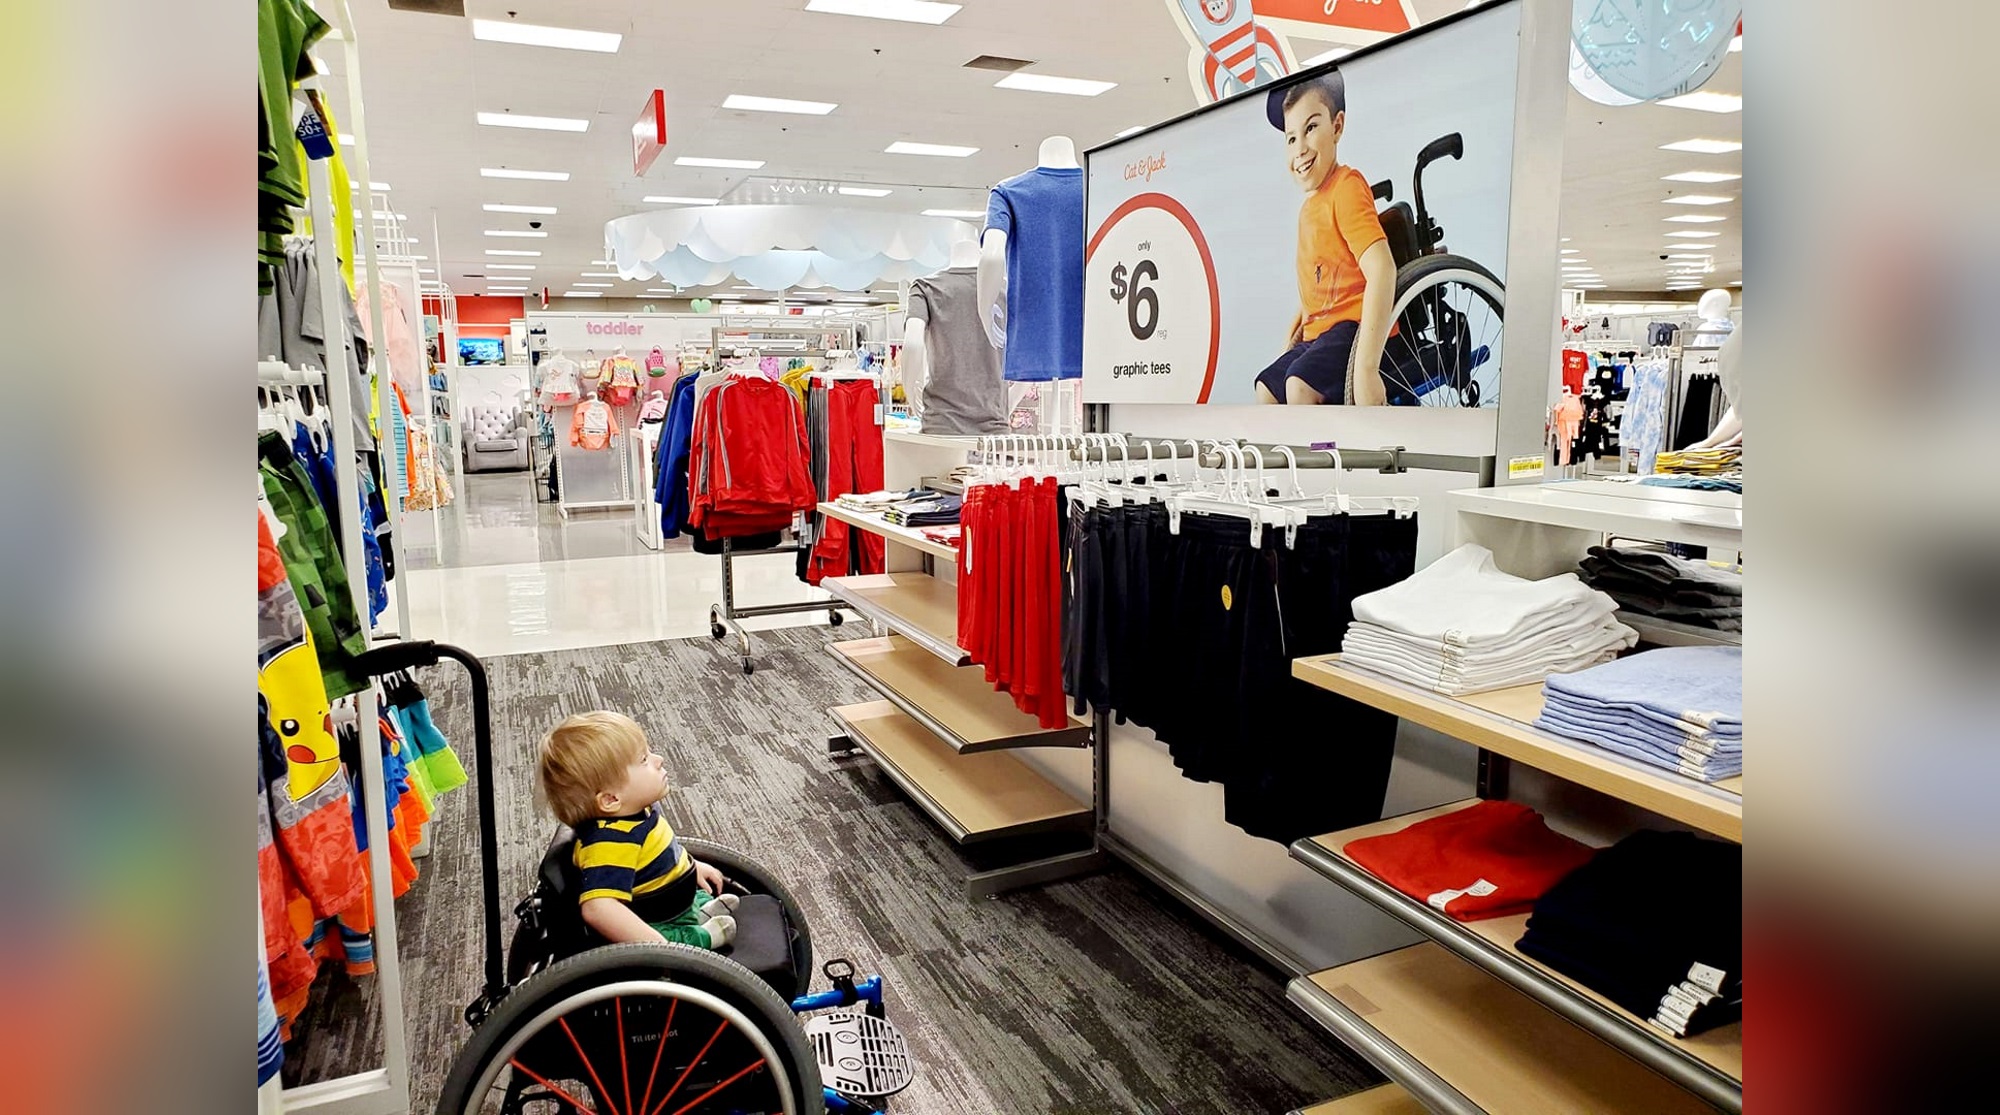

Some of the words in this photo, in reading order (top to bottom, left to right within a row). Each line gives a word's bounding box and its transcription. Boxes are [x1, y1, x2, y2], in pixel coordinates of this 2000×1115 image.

[300, 113, 318, 126] PF
[1124, 164, 1137, 180] Cat
[1138, 160, 1146, 175] &
[1145, 151, 1167, 182] Jack
[1138, 240, 1151, 251] only
[1110, 259, 1159, 340] $6
[586, 321, 644, 335] toddler
[1113, 361, 1149, 379] graphic
[1151, 361, 1171, 374] tees
